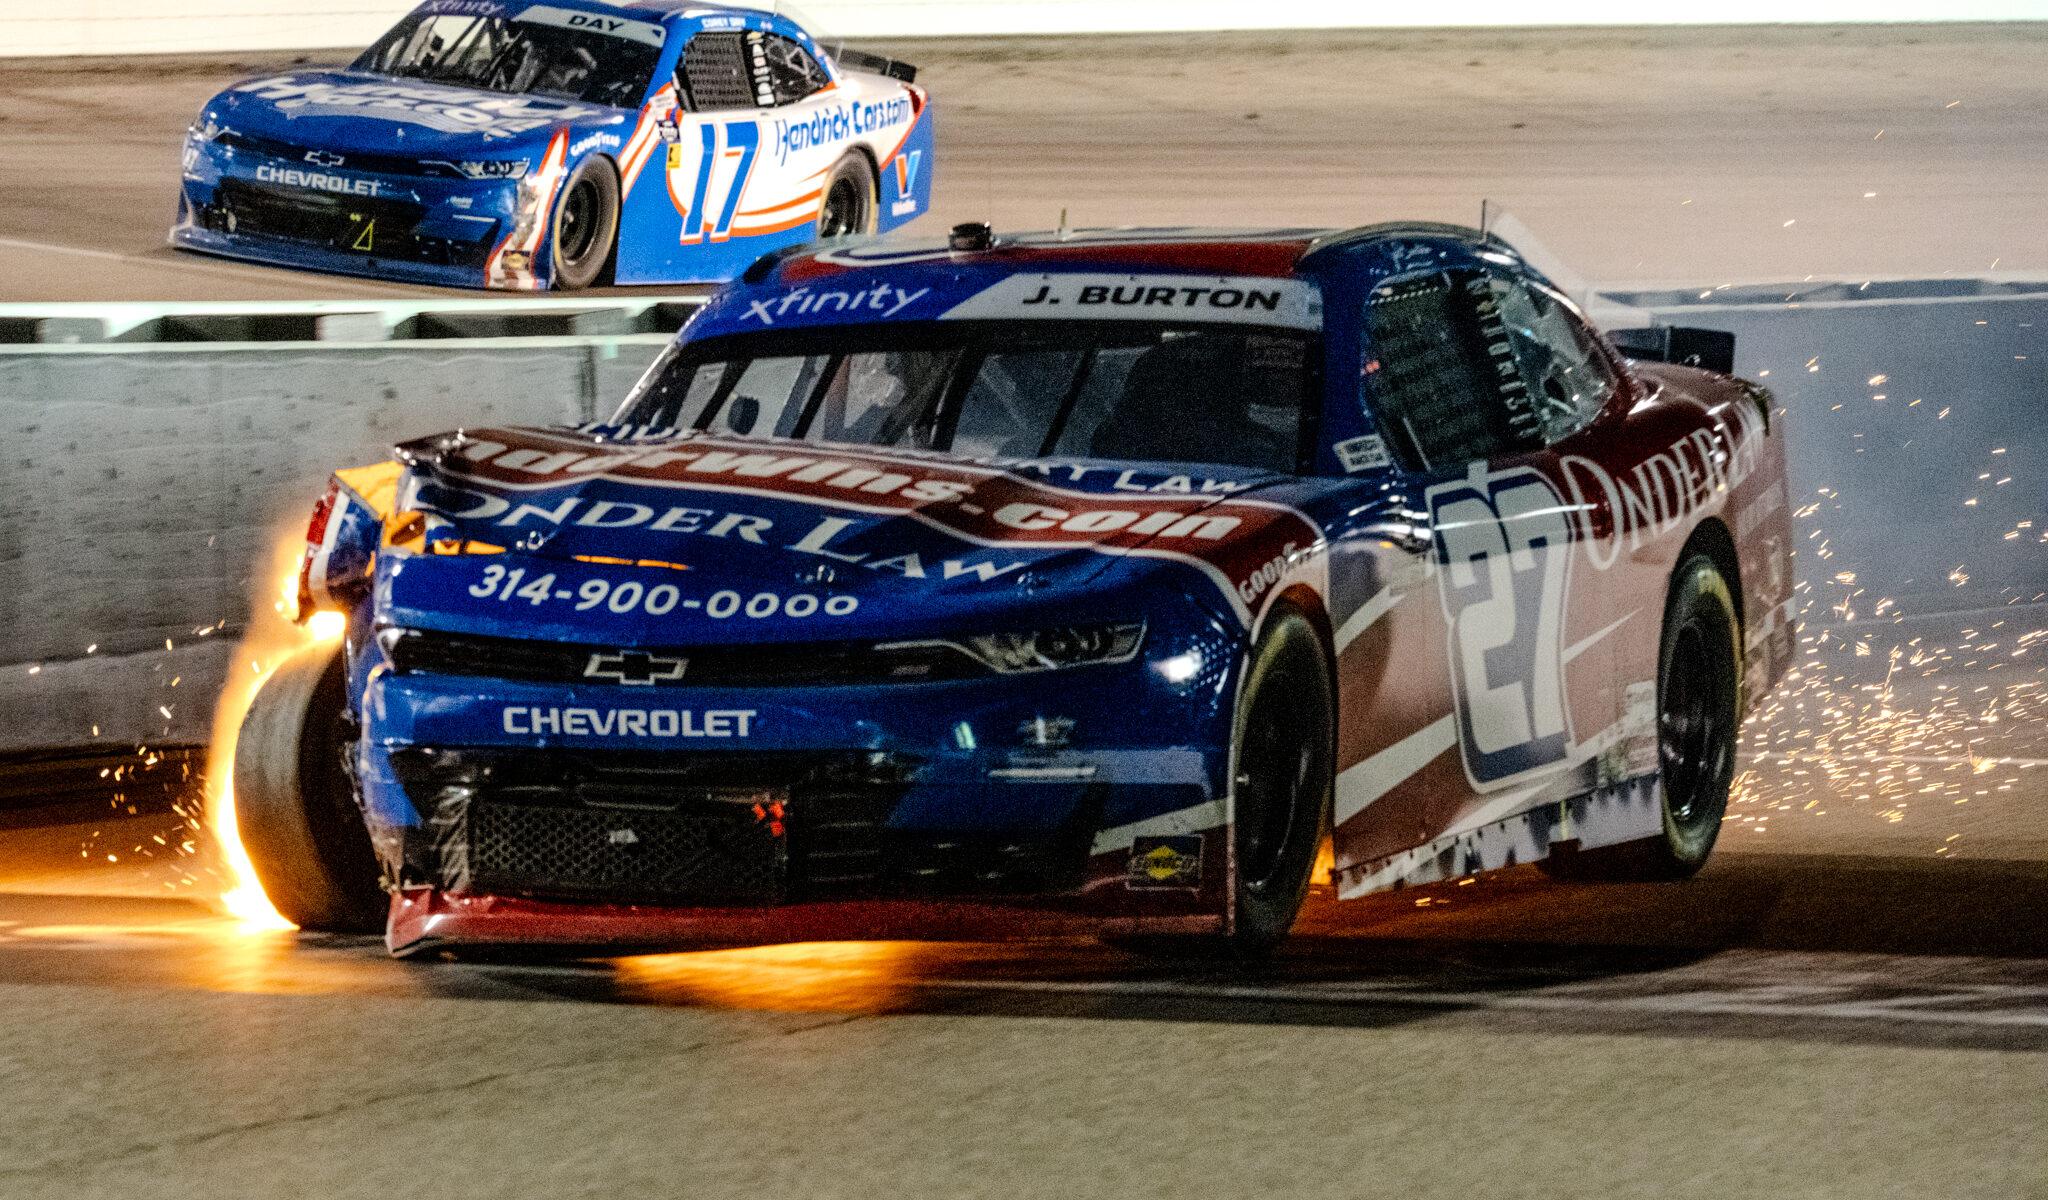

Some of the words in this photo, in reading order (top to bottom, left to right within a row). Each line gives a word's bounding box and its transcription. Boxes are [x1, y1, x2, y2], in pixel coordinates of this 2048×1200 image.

[567, 15, 626, 32] DAY
[256, 165, 380, 197] CHEVROLET
[681, 120, 761, 243] 17
[739, 284, 930, 325] xfinity
[1022, 286, 1060, 304] J.
[1077, 286, 1281, 310] BURTON
[783, 515, 1029, 582] LAW
[468, 564, 859, 618] 314-900-0000
[1426, 464, 1576, 793] 27
[502, 706, 757, 738] CHEVROLET
